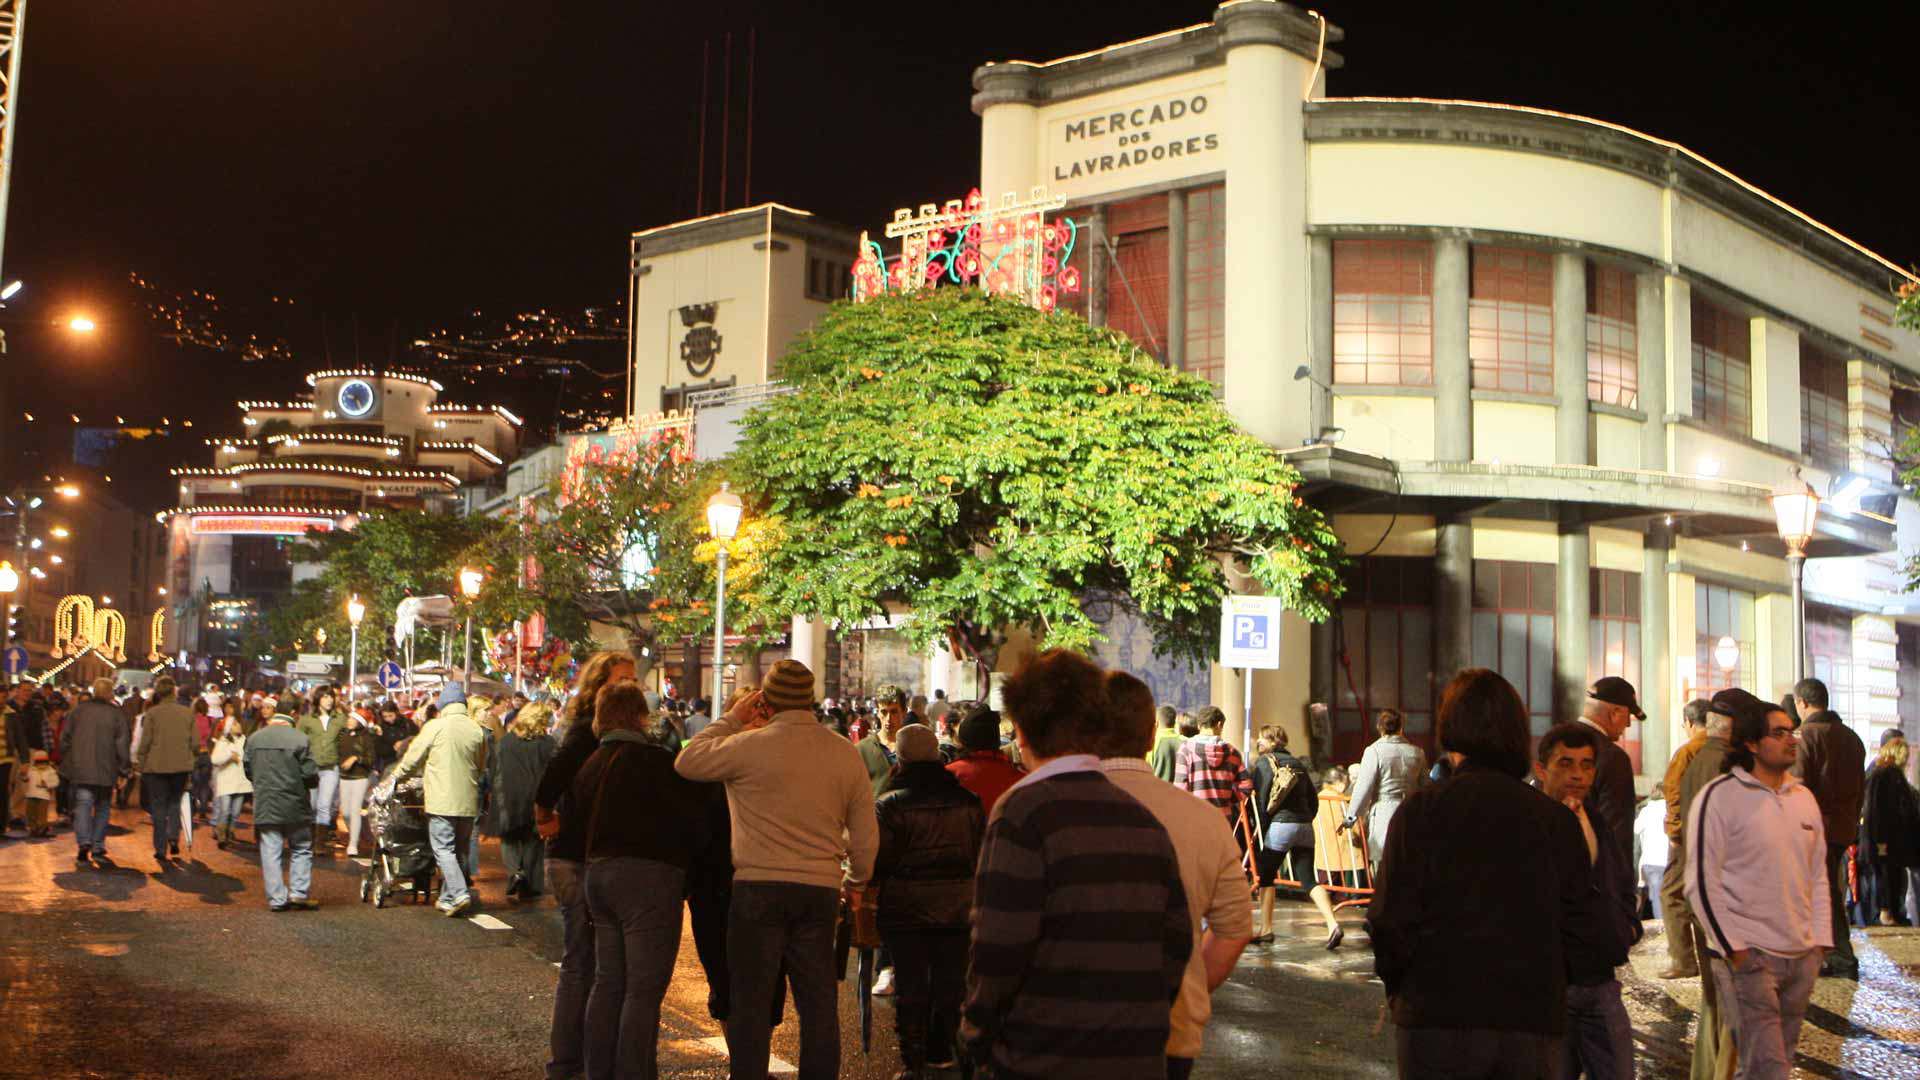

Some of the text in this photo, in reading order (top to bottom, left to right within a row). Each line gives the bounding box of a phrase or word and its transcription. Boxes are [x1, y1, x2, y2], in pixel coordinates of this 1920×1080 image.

[1065, 96, 1208, 143] MERCADO
[1118, 131, 1152, 147] DOS
[1054, 133, 1219, 181] LAVRADORES
